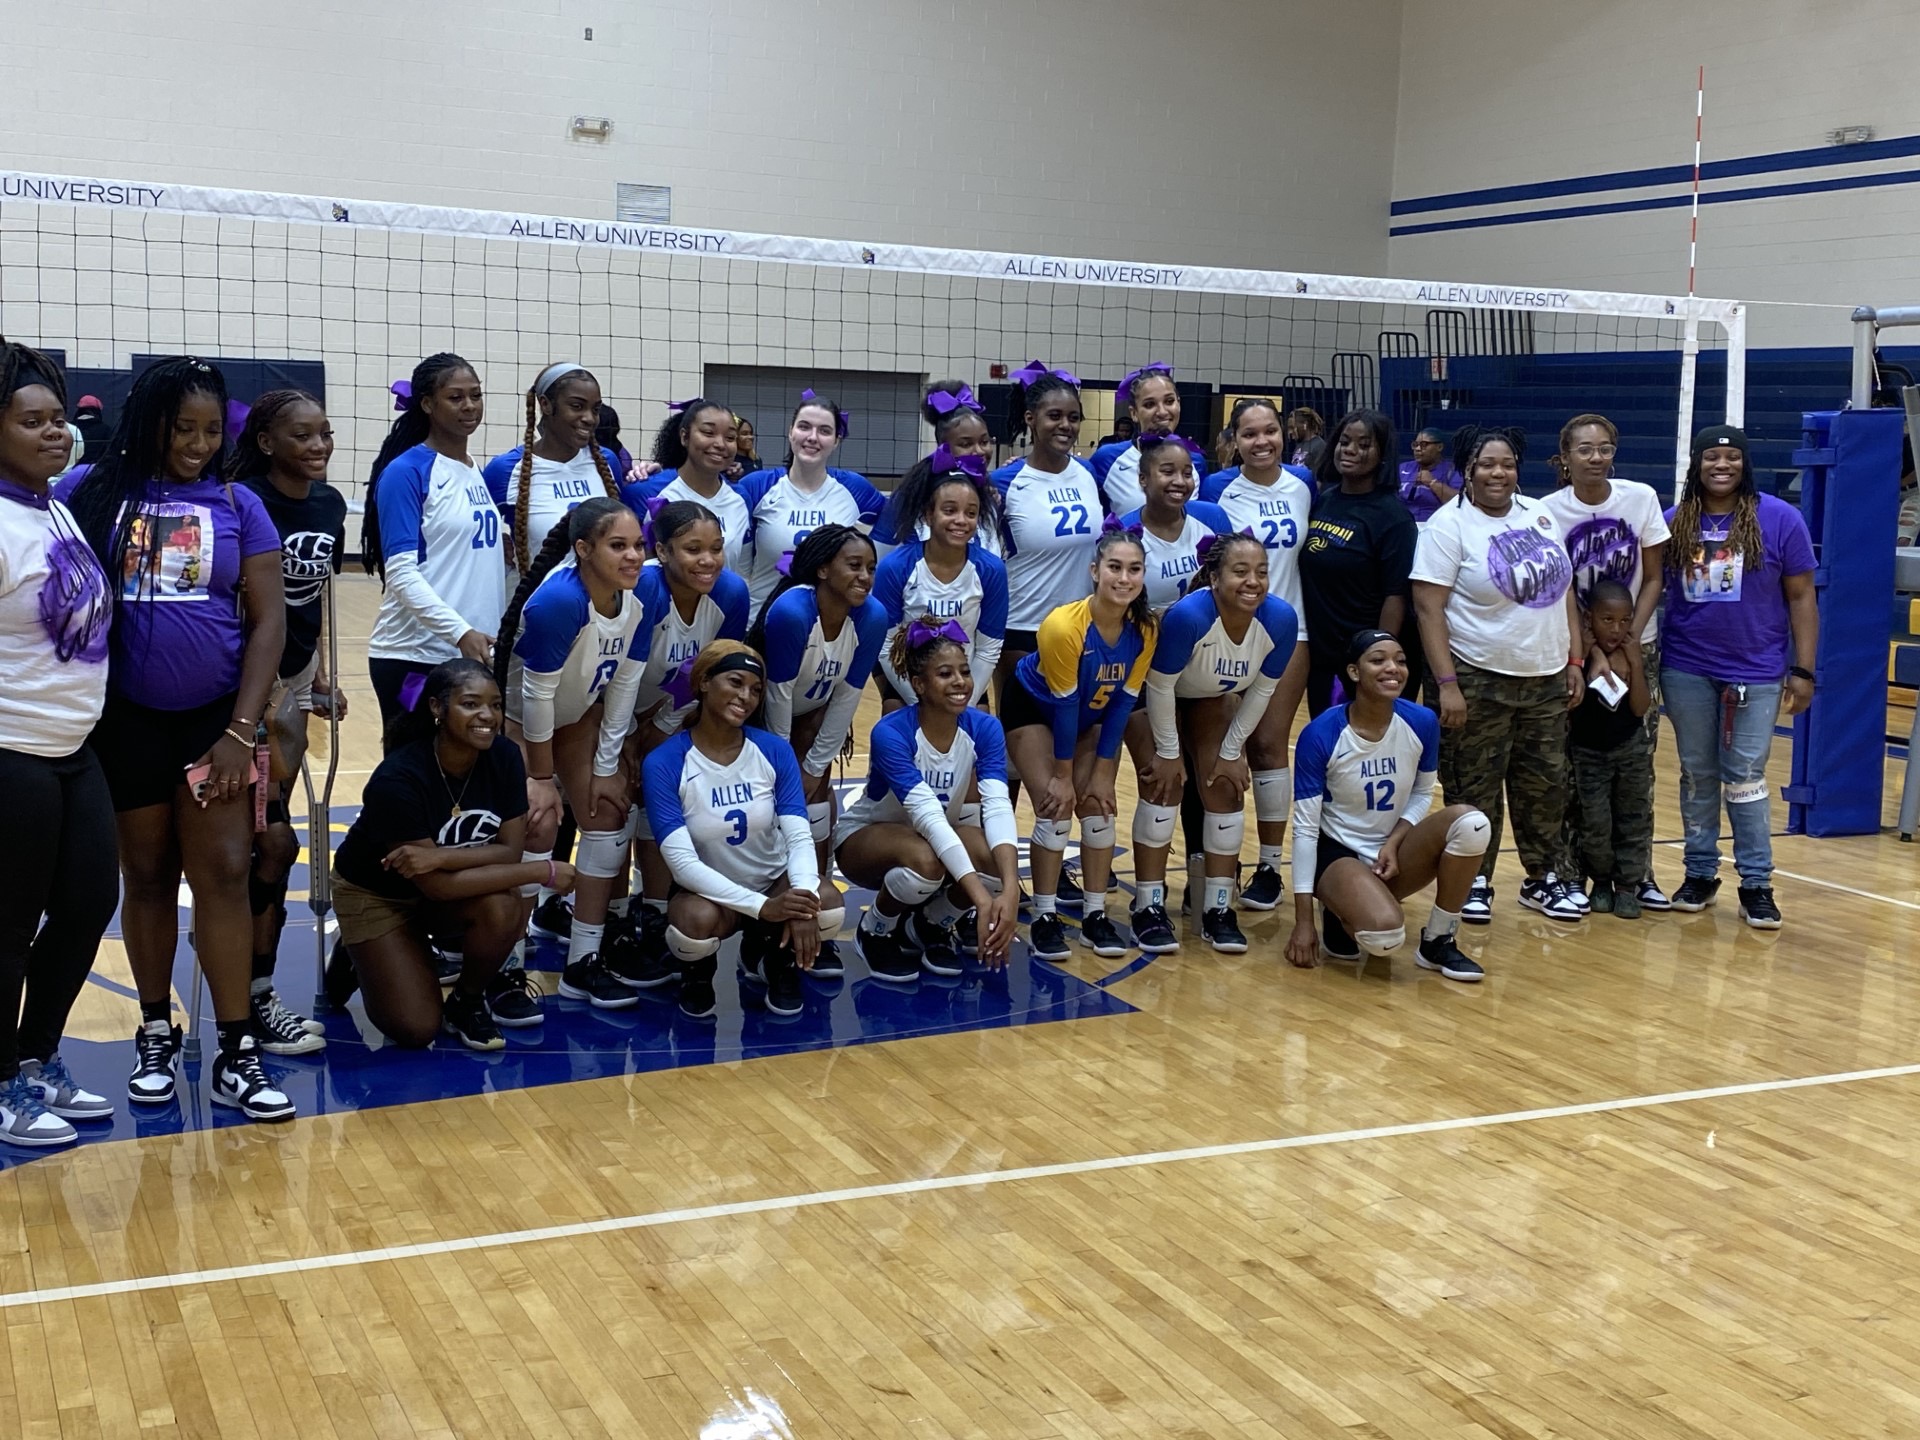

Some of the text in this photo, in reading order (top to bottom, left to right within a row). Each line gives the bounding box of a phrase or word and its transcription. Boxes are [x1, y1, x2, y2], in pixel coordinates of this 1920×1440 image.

[3, 177, 164, 207] UNIVERSITY
[509, 219, 726, 252] ALLEN UNIVERSITY
[1004, 259, 1184, 285] ALLEN UNIVERSITY
[1416, 286, 1570, 308] ALLEN UNIVERSITY
[552, 480, 592, 499] ALLEN
[1047, 487, 1082, 504] ALLEN
[787, 510, 827, 526] ALLEN
[1051, 504, 1091, 537] 22
[1259, 500, 1291, 517] ALLEN
[472, 509, 498, 549] 20
[1261, 518, 1298, 549] 23
[1161, 555, 1199, 580] ALLEN
[927, 599, 963, 618] ALLEN
[1095, 662, 1126, 682] ALLEN
[1214, 657, 1249, 678] ALLEN
[1089, 684, 1116, 709] 5
[1360, 756, 1397, 779] ALLEN
[712, 782, 754, 809] ALLEN
[1363, 779, 1396, 811] 12
[724, 808, 748, 847] 3
